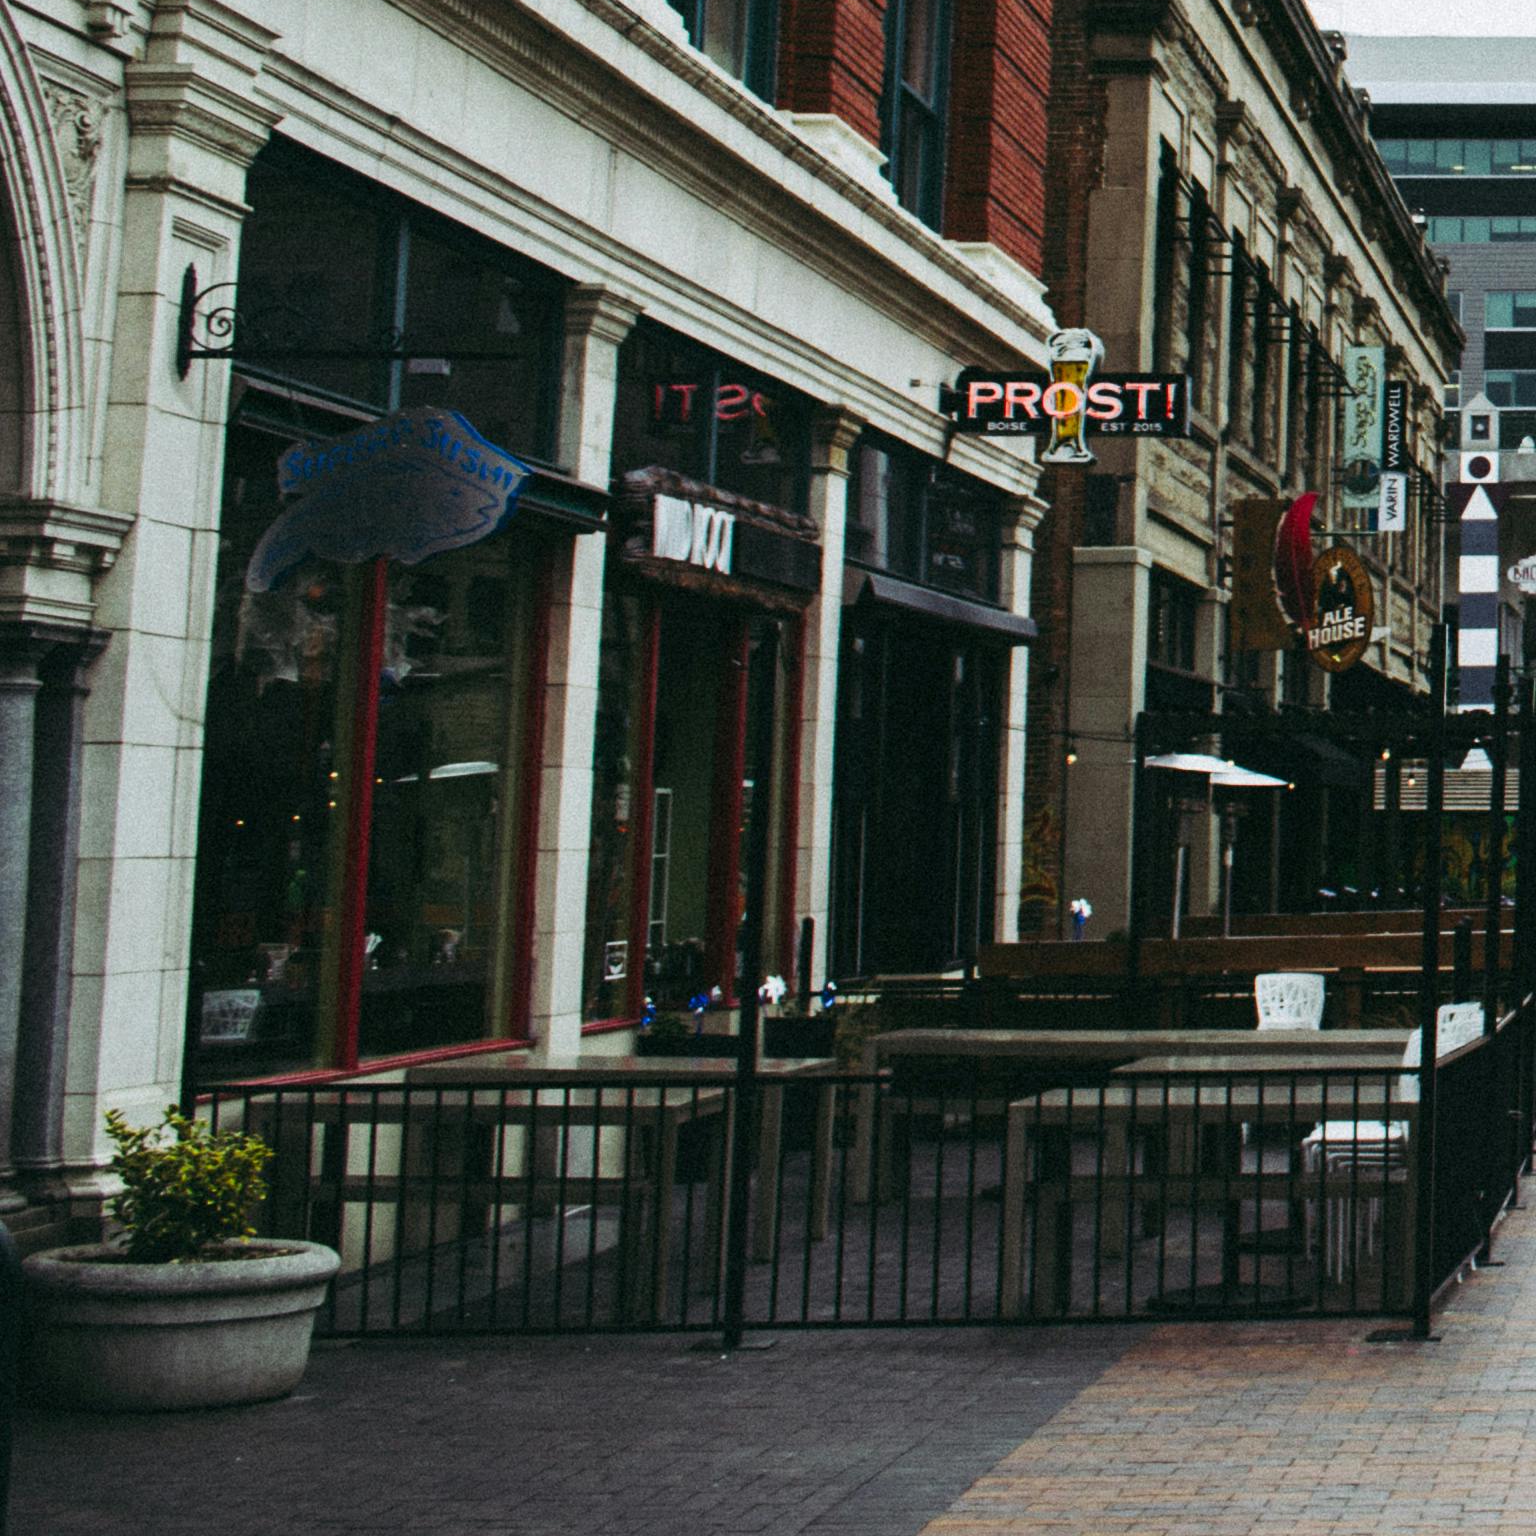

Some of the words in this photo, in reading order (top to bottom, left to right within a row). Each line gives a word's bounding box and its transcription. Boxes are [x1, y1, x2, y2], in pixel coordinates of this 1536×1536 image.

[967, 381, 1178, 420] PROST!
[987, 421, 1028, 432] BOISE
[1101, 421, 1125, 432] EST
[1132, 422, 1163, 432] 2015
[1387, 387, 1401, 468] WARDWELL
[1386, 478, 1400, 522] VARIN
[1307, 616, 1367, 651] HOUSE
[1322, 606, 1354, 627] ALE
